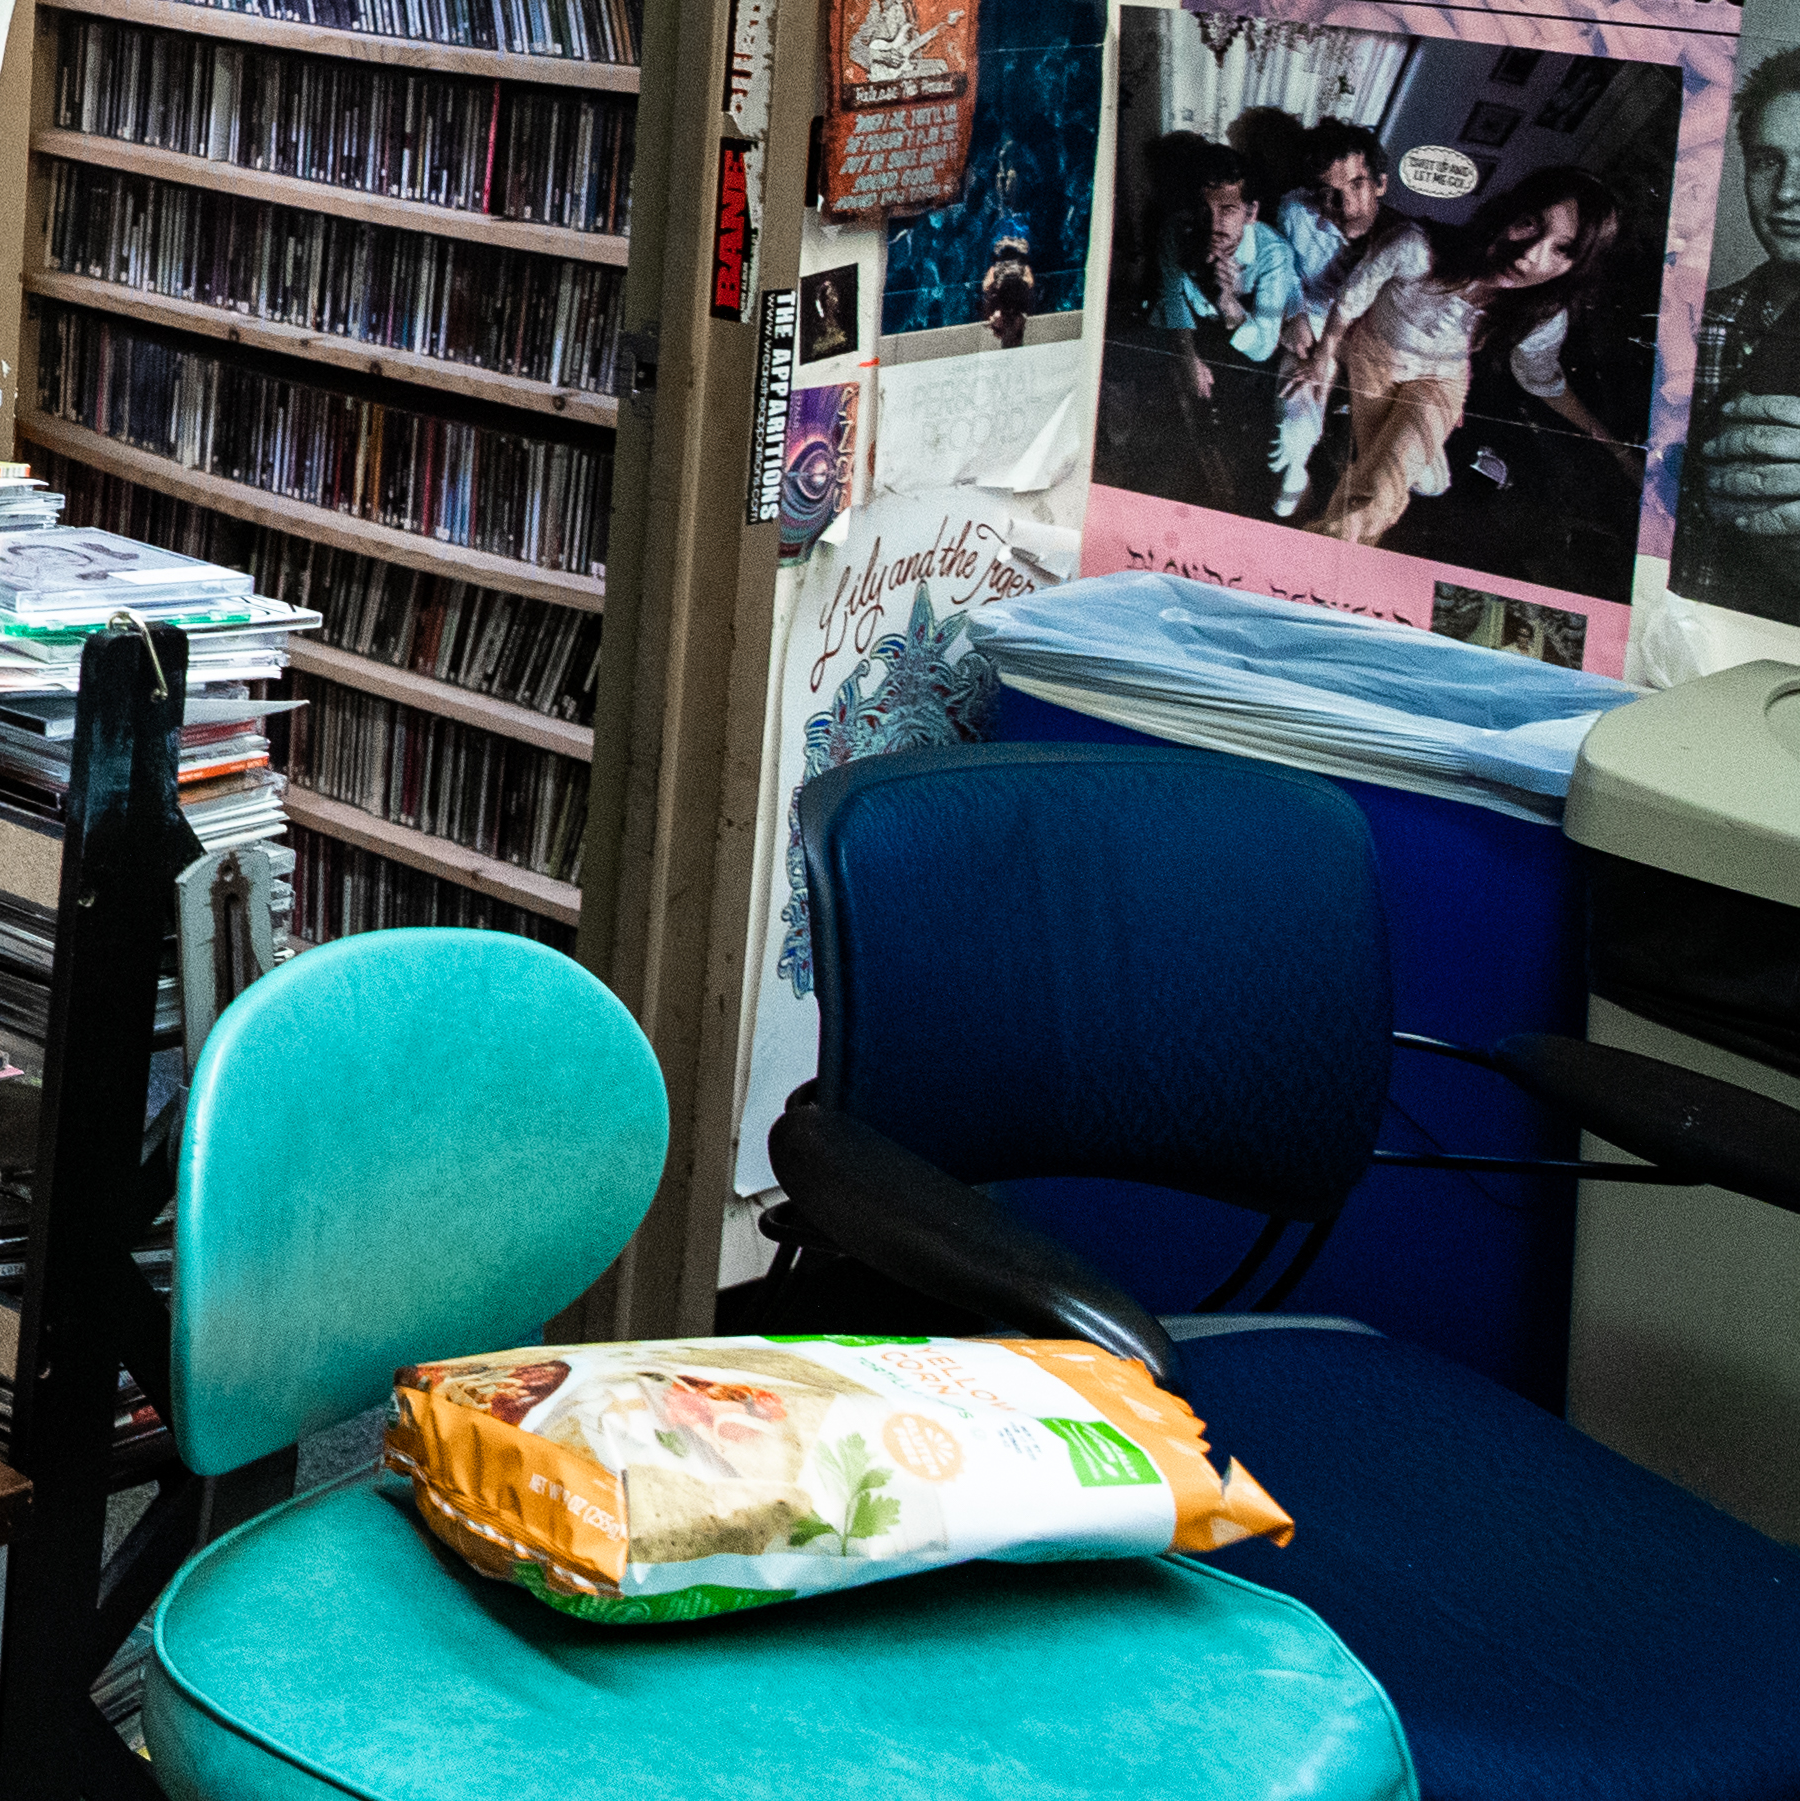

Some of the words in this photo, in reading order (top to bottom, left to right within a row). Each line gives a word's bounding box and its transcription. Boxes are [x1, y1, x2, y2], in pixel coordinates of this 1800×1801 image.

[714, 148, 747, 310] BANE
[772, 290, 797, 340] THE
[759, 348, 793, 522] APPARITIONS
[888, 516, 937, 584] and
[938, 522, 980, 578] the
[880, 1350, 960, 1397] CORN
